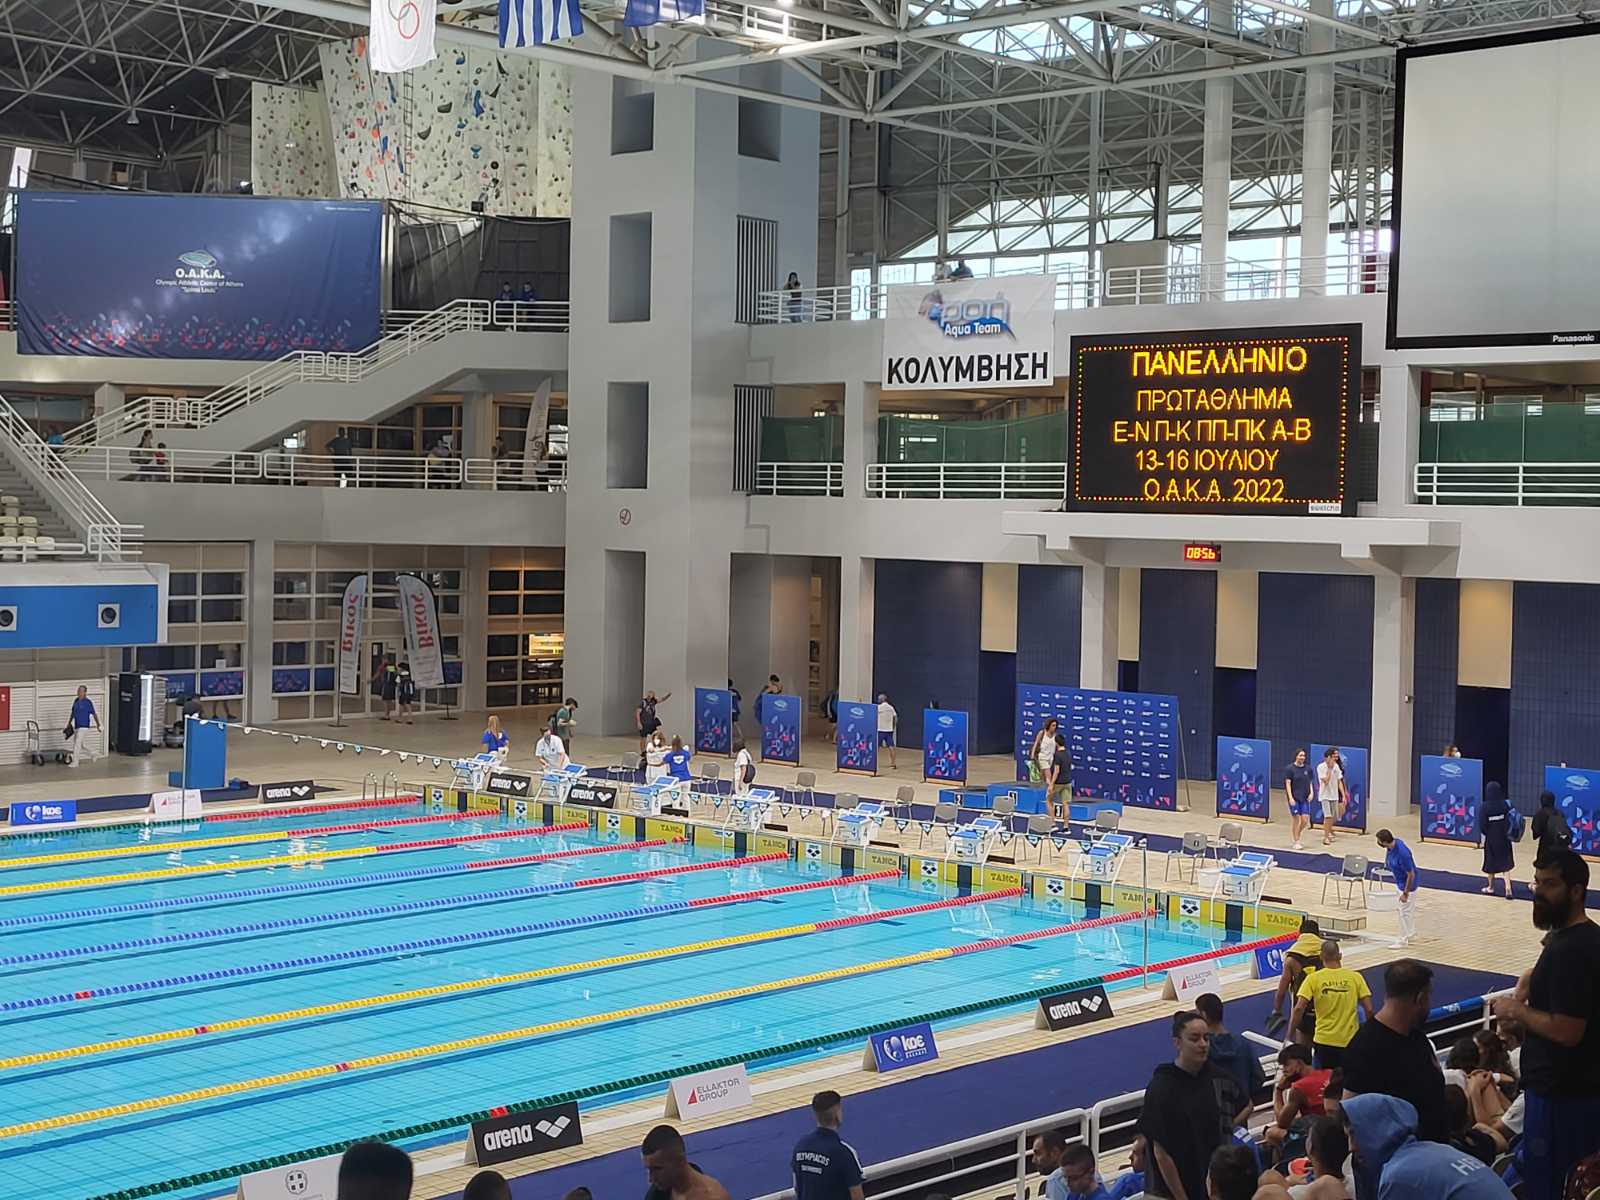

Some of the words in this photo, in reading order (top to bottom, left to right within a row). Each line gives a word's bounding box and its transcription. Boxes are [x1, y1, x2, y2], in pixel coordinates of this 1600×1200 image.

[944, 323, 971, 337] Aqua
[974, 321, 1001, 335] Team
[1552, 333, 1595, 343] Panasonic
[887, 351, 1049, 385] ΚΟΛΥΜΒΗΣΗ
[1132, 346, 1308, 377] ΠΑΝΕΛΛΗΝΙΟ
[1137, 387, 1293, 412] ΠΡΩΤΑΘΛΗΜΑ
[1272, 418, 1313, 441] Α-Β
[1135, 449, 1190, 471] 13-16
[1194, 449, 1280, 471] ΙΟΥΛΙΟΥ
[1233, 478, 1285, 502] 2022
[570, 788, 595, 800] arena
[1095, 860, 1103, 873] 2
[1049, 999, 1082, 1020] arena
[696, 1077, 741, 1095] ELLAKTOR
[698, 1089, 729, 1103] GROUP
[483, 1123, 534, 1152] arena
